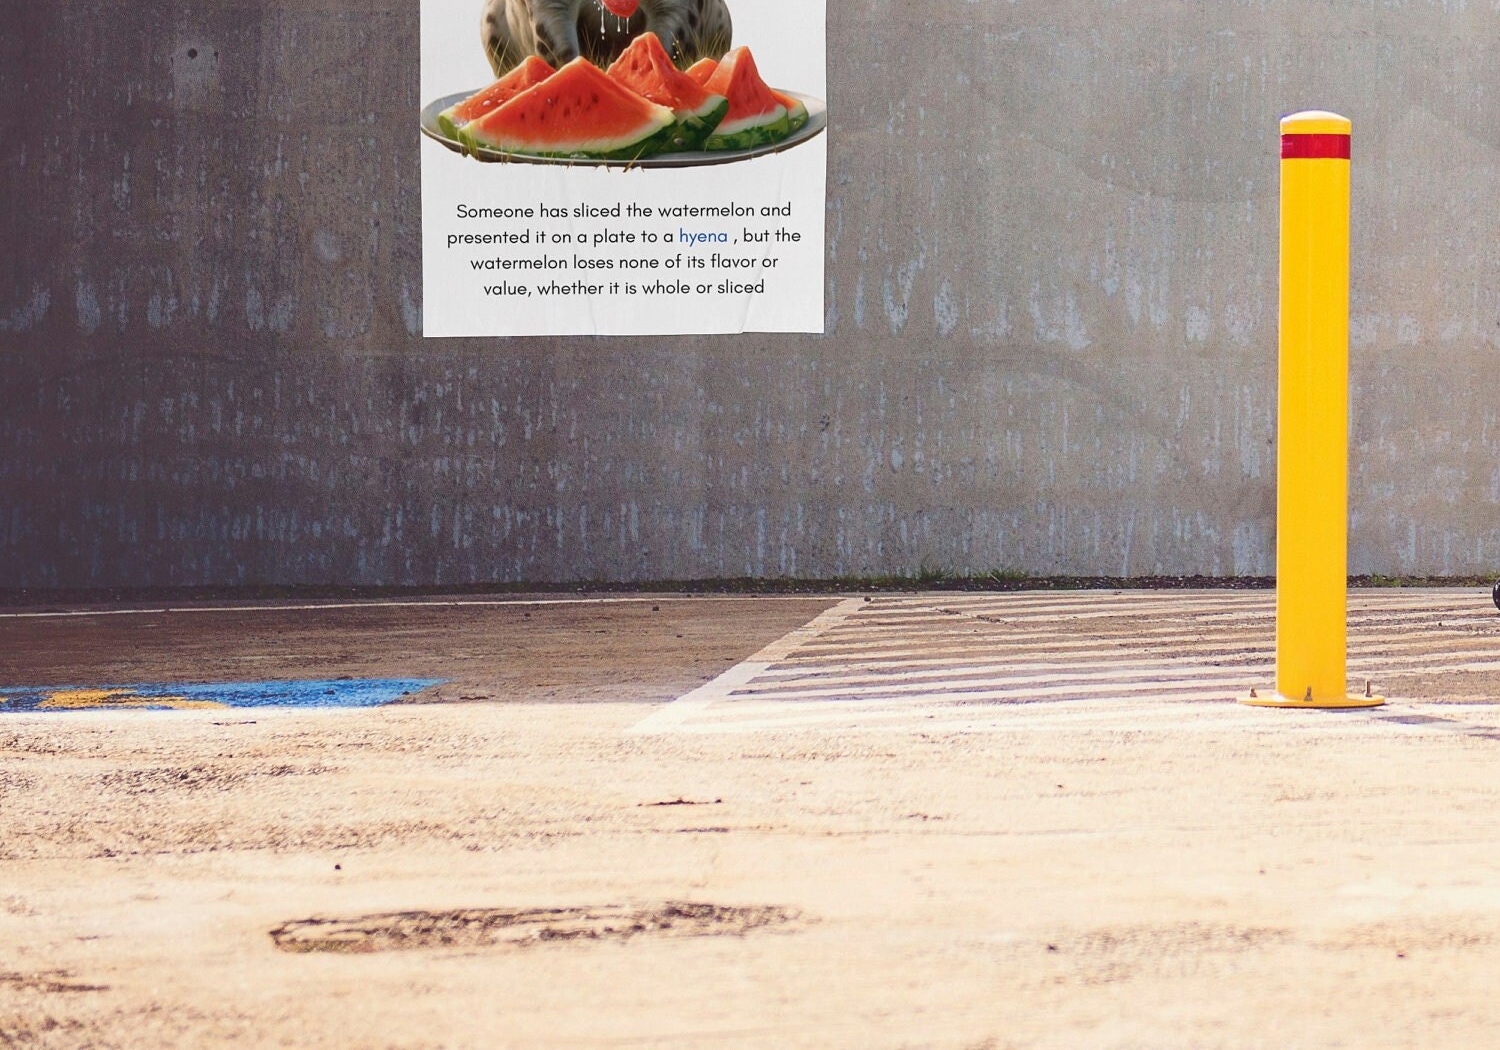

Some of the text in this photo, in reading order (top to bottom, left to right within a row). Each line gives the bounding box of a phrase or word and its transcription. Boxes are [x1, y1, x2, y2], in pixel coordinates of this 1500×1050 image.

[456, 201, 791, 219] Someone has sliced the watermelon and
[447, 228, 530, 249] presented
[535, 230, 547, 244] it
[551, 233, 572, 244] on
[577, 233, 587, 244] a
[593, 227, 636, 248] plate
[640, 230, 658, 243] to
[663, 233, 674, 243] a
[679, 227, 728, 248] hyena
[743, 227, 770, 243] but
[774, 226, 801, 242] the
[470, 253, 779, 271] watermelon loses none of its flavor or
[483, 278, 765, 298] value, whether it is whole or sliced
